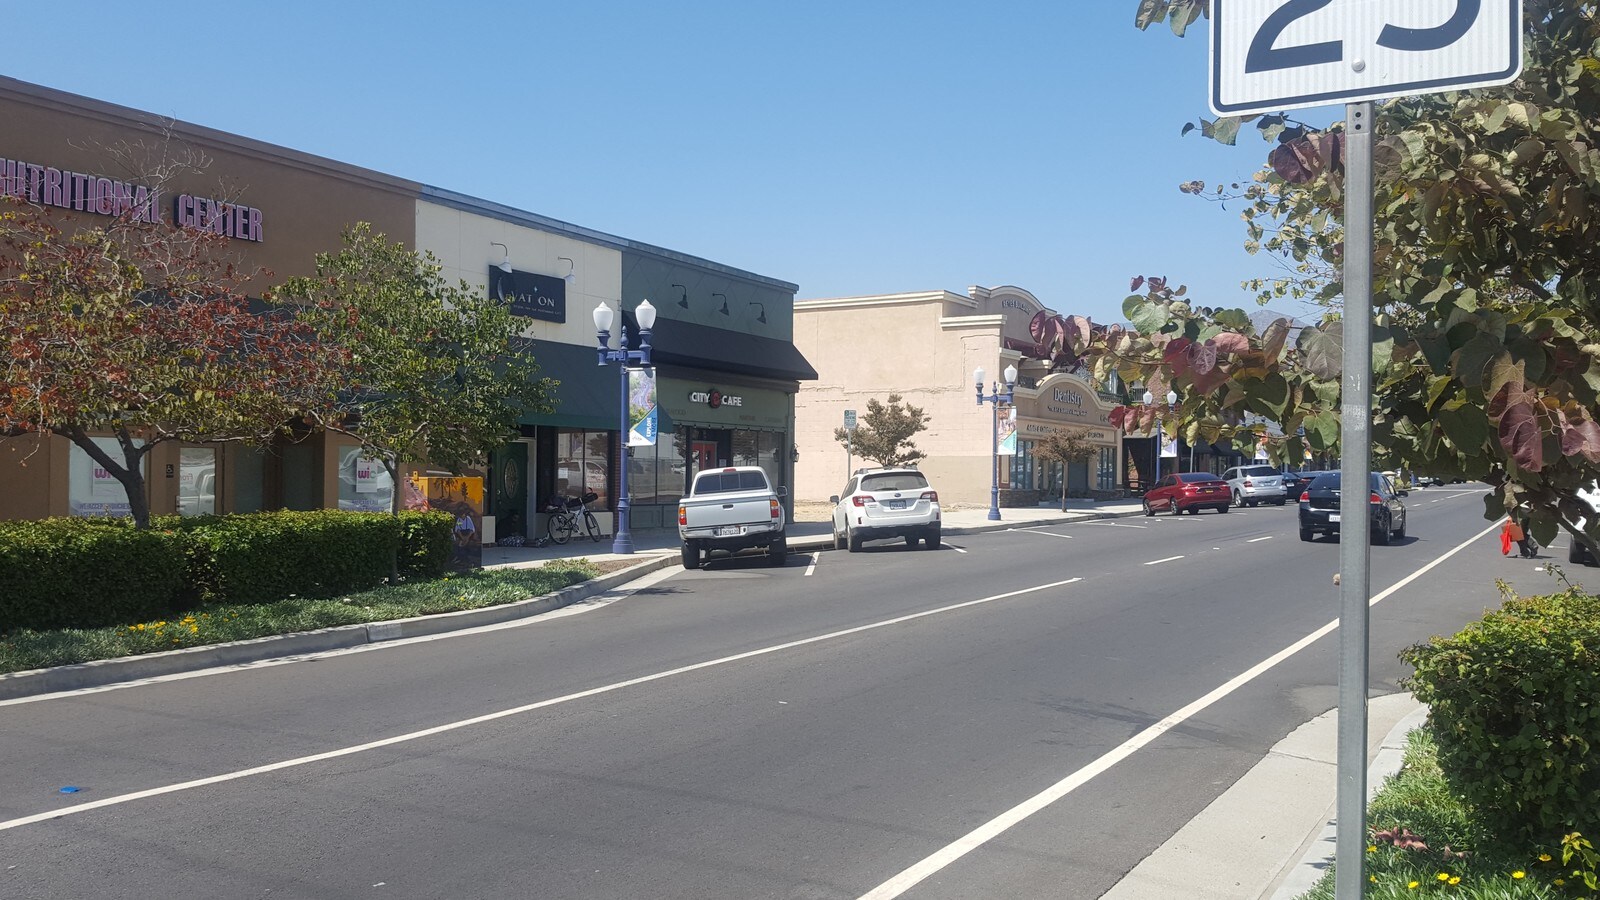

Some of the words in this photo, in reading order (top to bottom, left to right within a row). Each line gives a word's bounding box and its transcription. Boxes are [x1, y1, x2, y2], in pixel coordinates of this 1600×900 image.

[0, 157, 160, 224] UTRITIONAL
[175, 192, 264, 243] CENTER
[691, 392, 710, 403] CITY
[721, 395, 742, 407] CAFE
[1053, 387, 1083, 408] Dentistry
